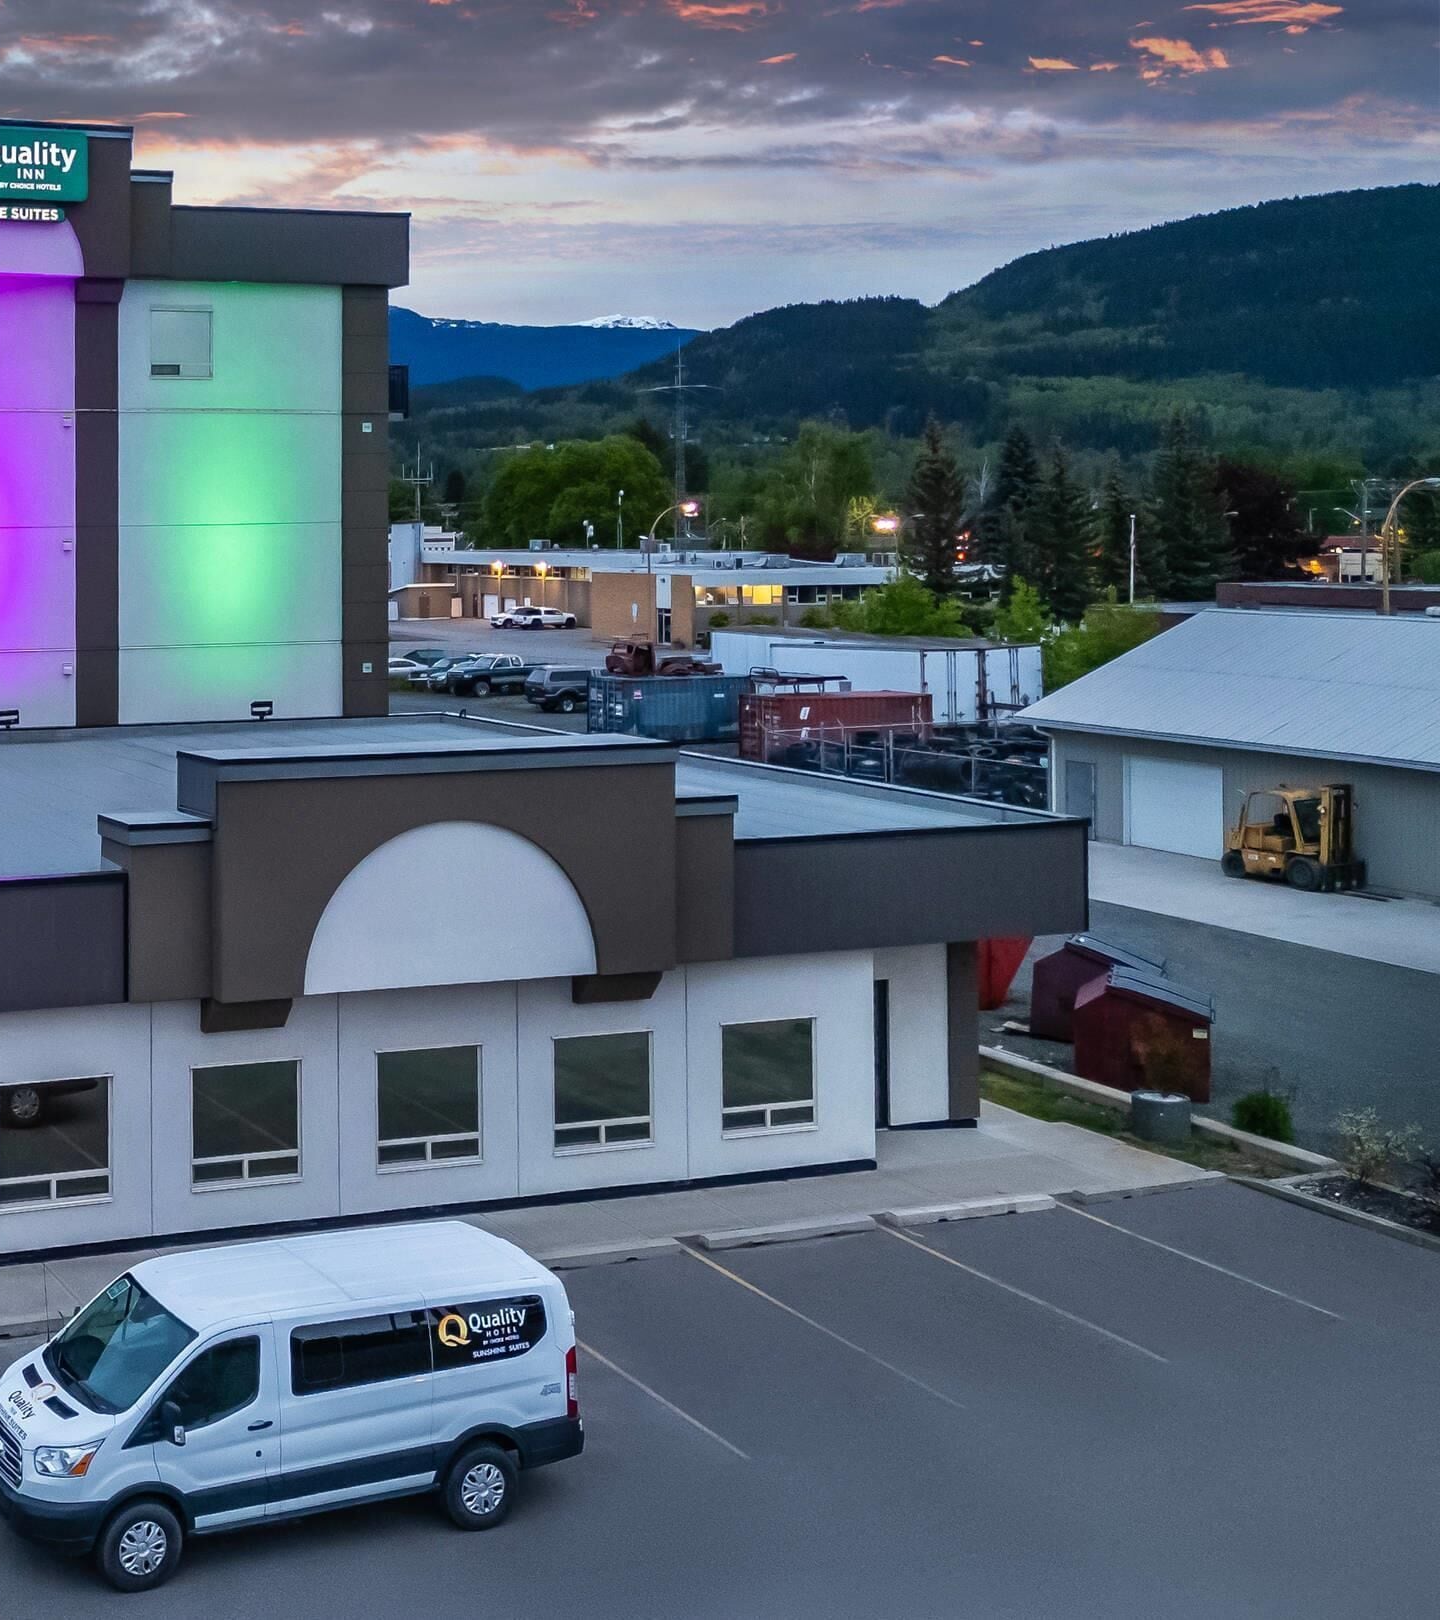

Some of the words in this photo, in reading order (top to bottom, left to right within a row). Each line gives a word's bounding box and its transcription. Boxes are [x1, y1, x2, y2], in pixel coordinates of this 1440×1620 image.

[17, 168, 45, 180] INN
[0, 181, 9, 189] BY
[9, 182, 35, 190] CHOICE
[36, 183, 62, 191] HOTELS
[10, 207, 59, 221] SUITES
[468, 1307, 527, 1333] Quality
[486, 1326, 517, 1338] HOTEL
[508, 1341, 530, 1352] SUITES
[8, 1390, 36, 1420] Quality
[9, 1418, 28, 1441] SUITES
